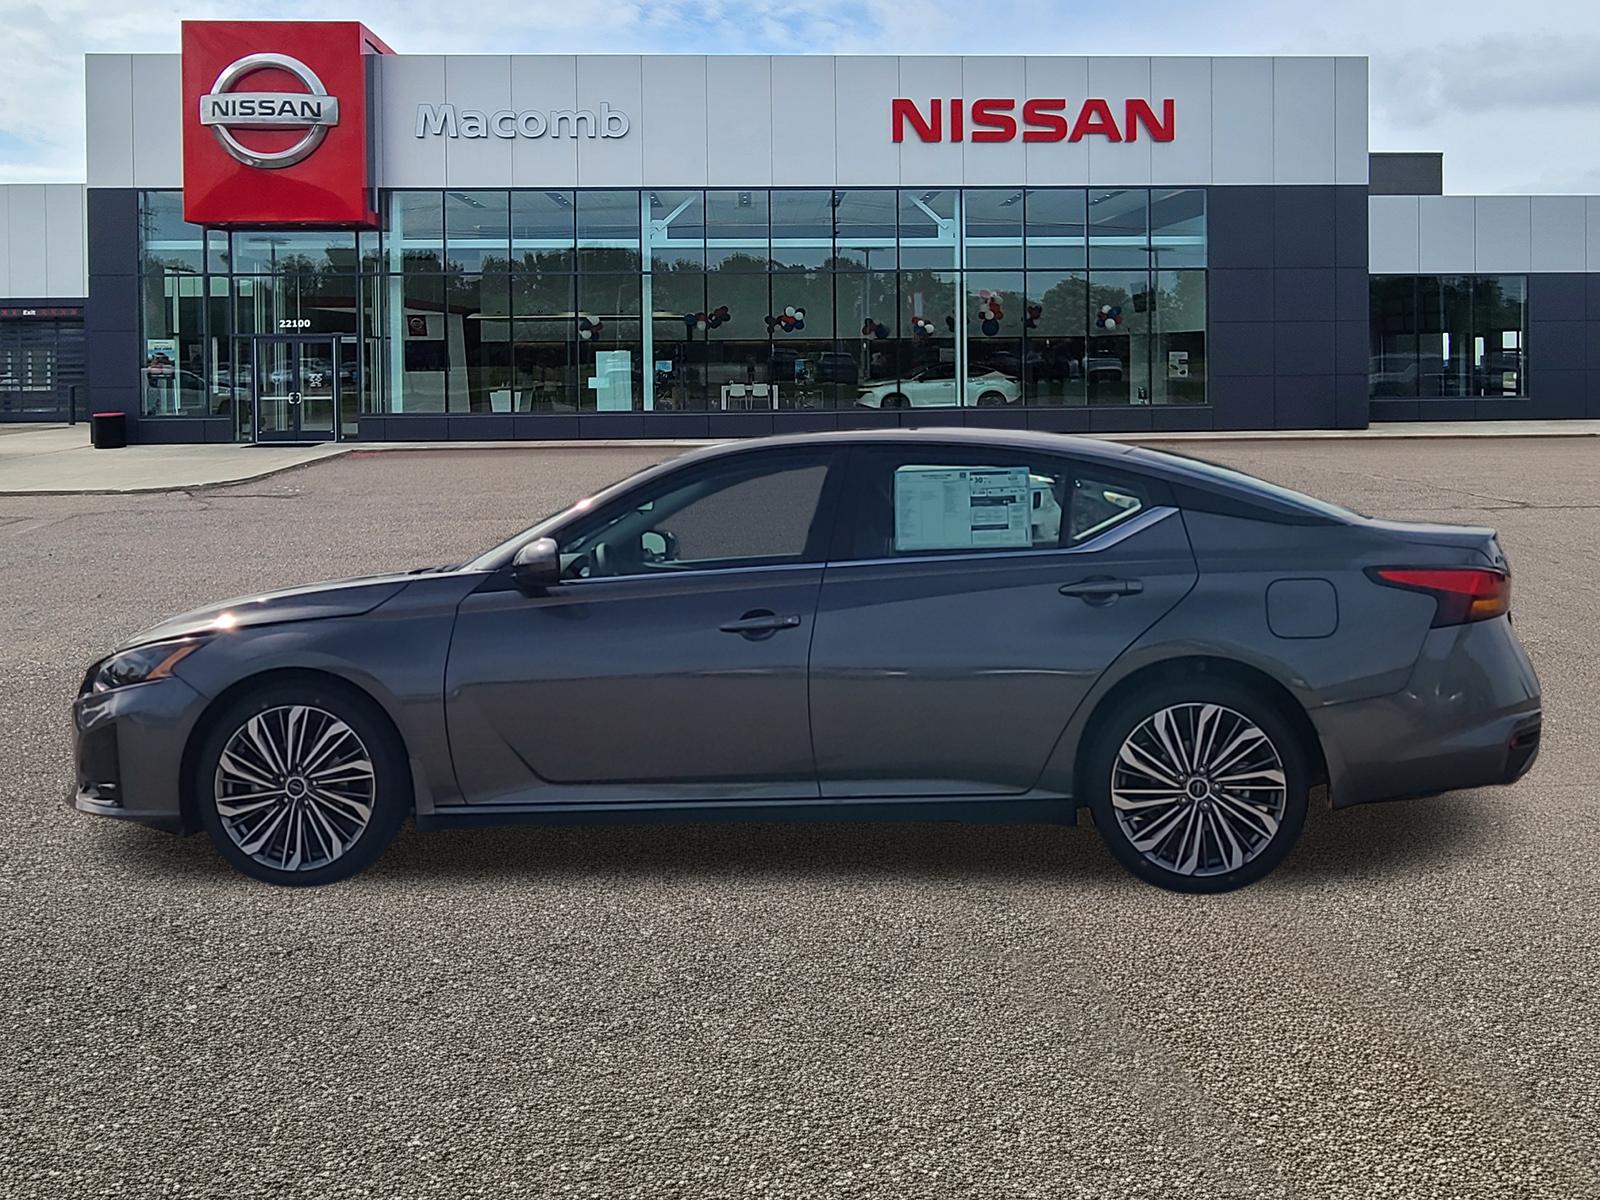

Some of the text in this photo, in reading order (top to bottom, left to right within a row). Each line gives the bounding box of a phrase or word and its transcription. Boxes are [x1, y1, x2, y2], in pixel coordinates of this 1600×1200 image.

[211, 100, 322, 118] NISSAN
[415, 101, 631, 139] Macomb
[891, 98, 1176, 143] NISSAN
[279, 319, 311, 328] 22100
